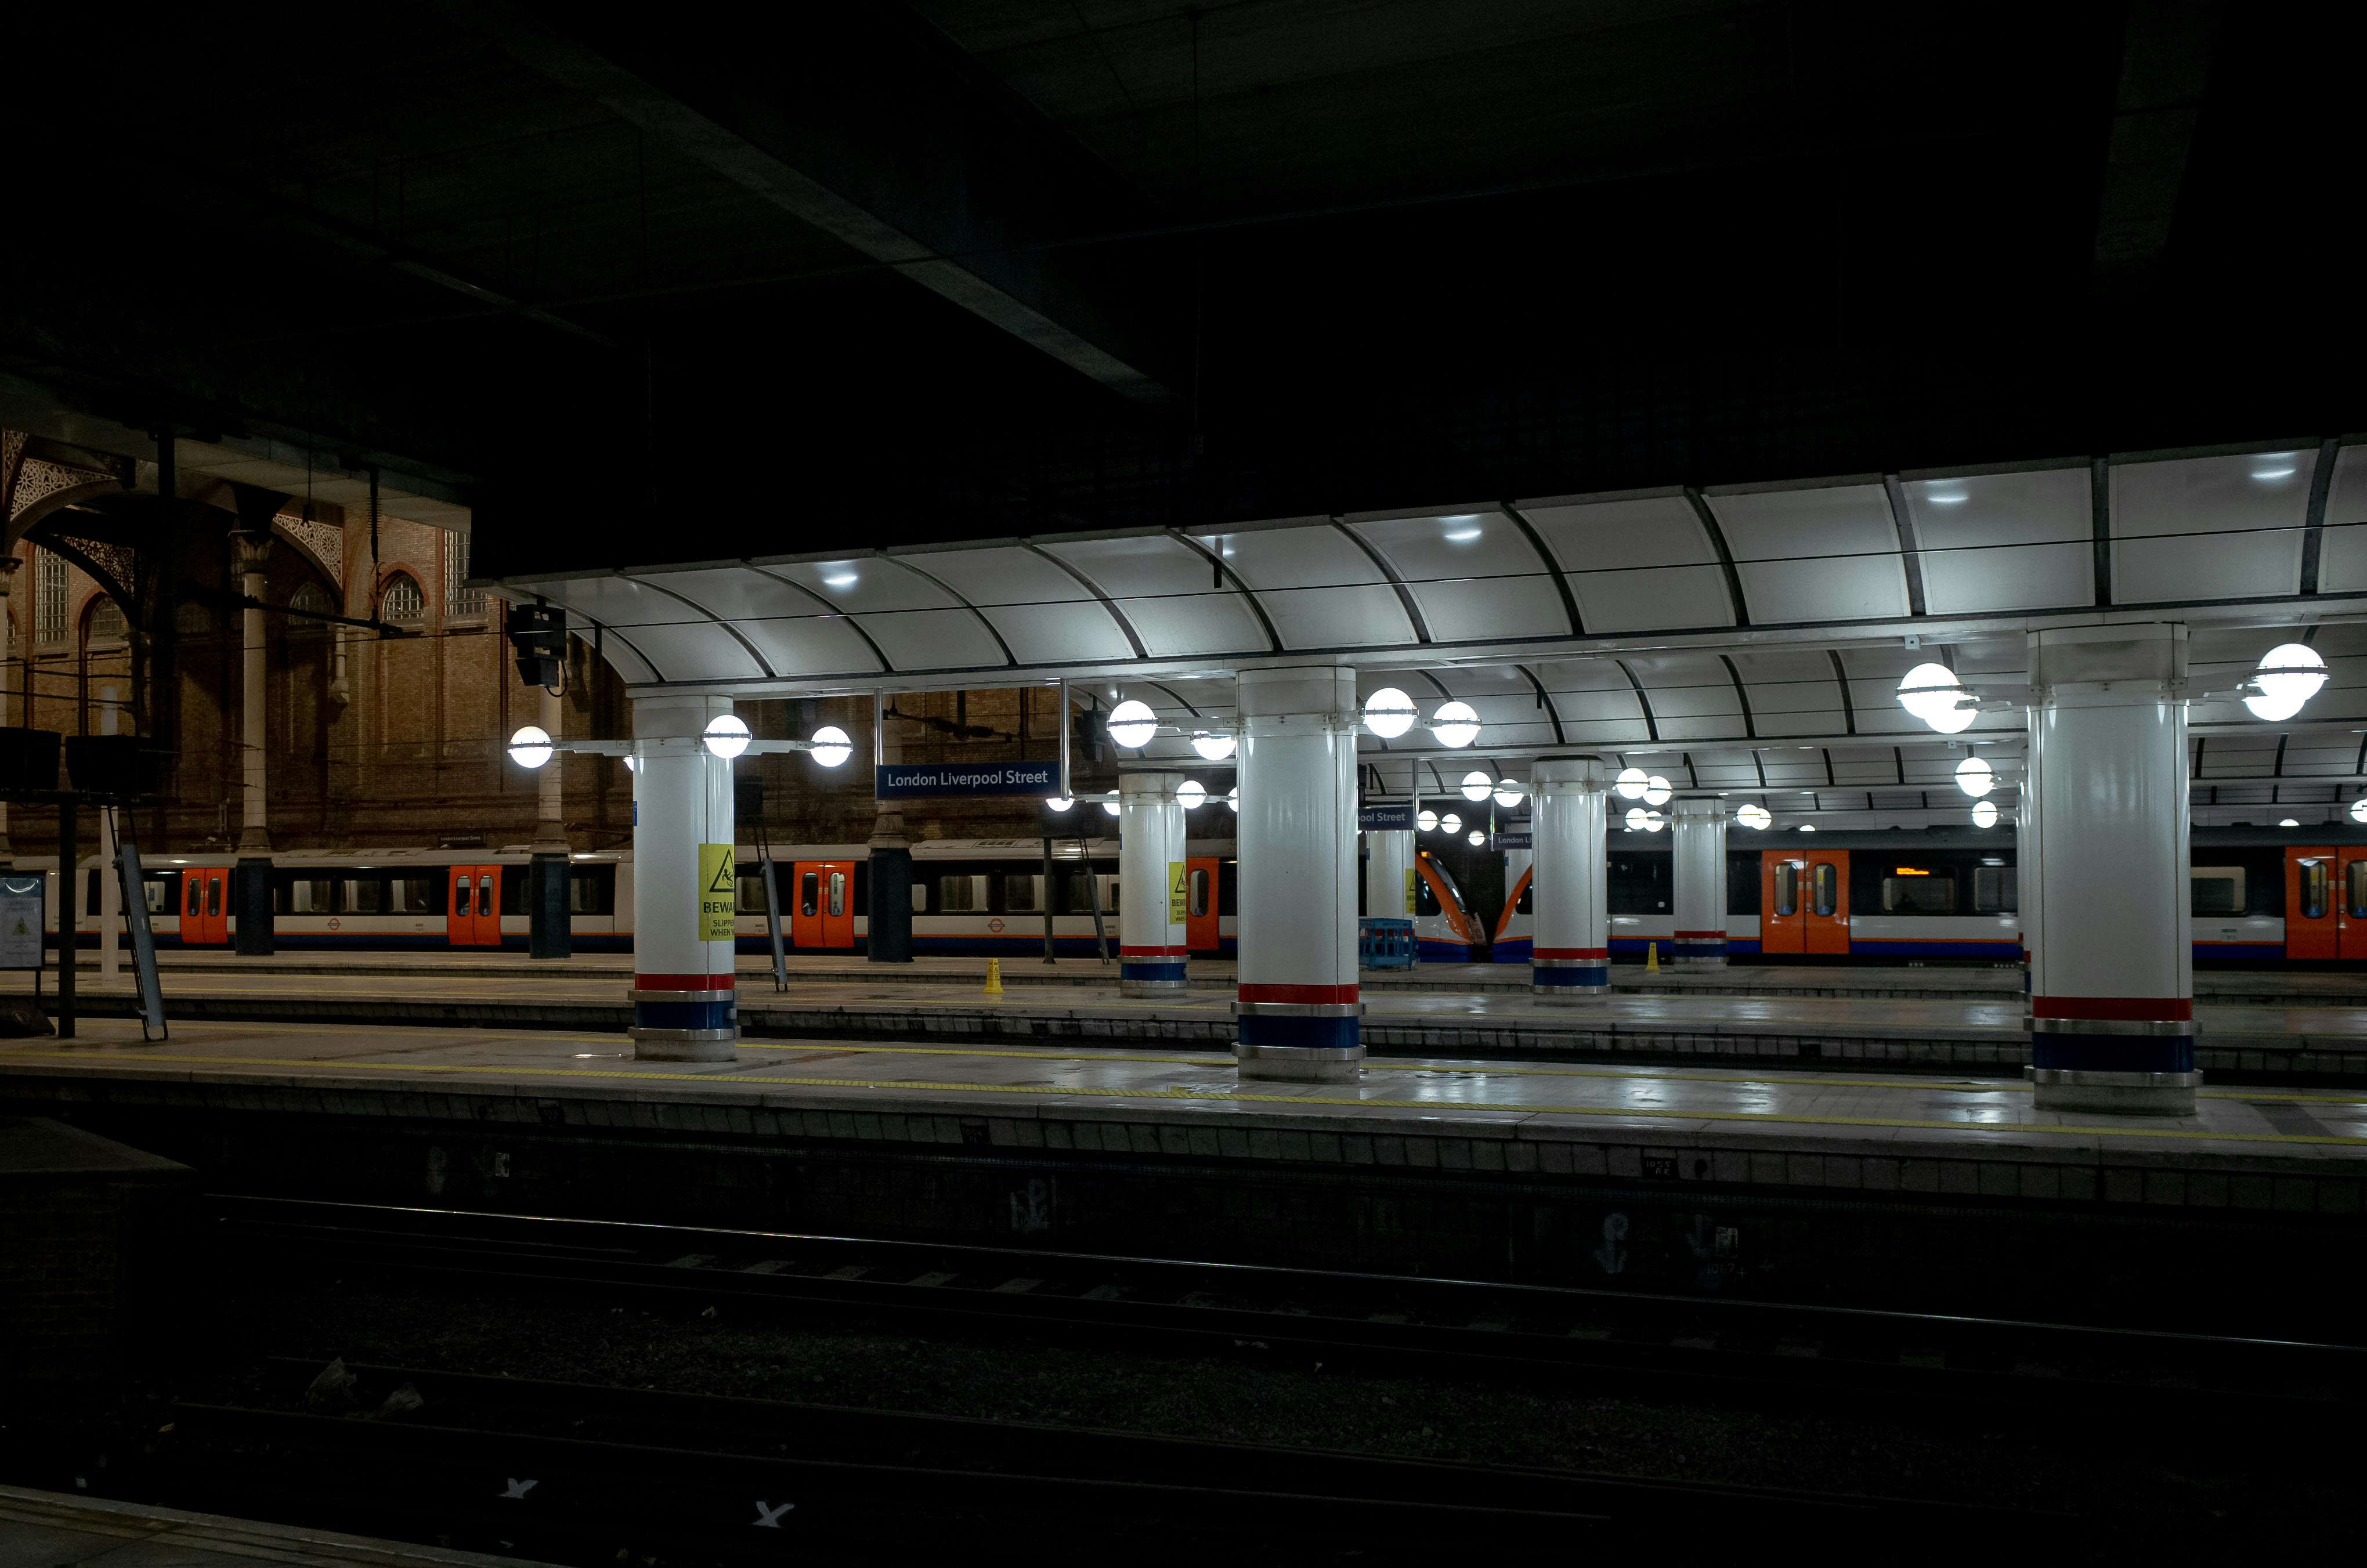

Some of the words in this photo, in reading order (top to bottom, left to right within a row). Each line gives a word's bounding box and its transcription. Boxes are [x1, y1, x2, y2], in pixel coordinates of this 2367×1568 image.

[888, 774, 937, 786] London
[941, 771, 1002, 787] Liverpool
[1006, 770, 1048, 784] Street
[1377, 812, 1405, 822] Street
[1656, 1168, 1670, 1176] RE
